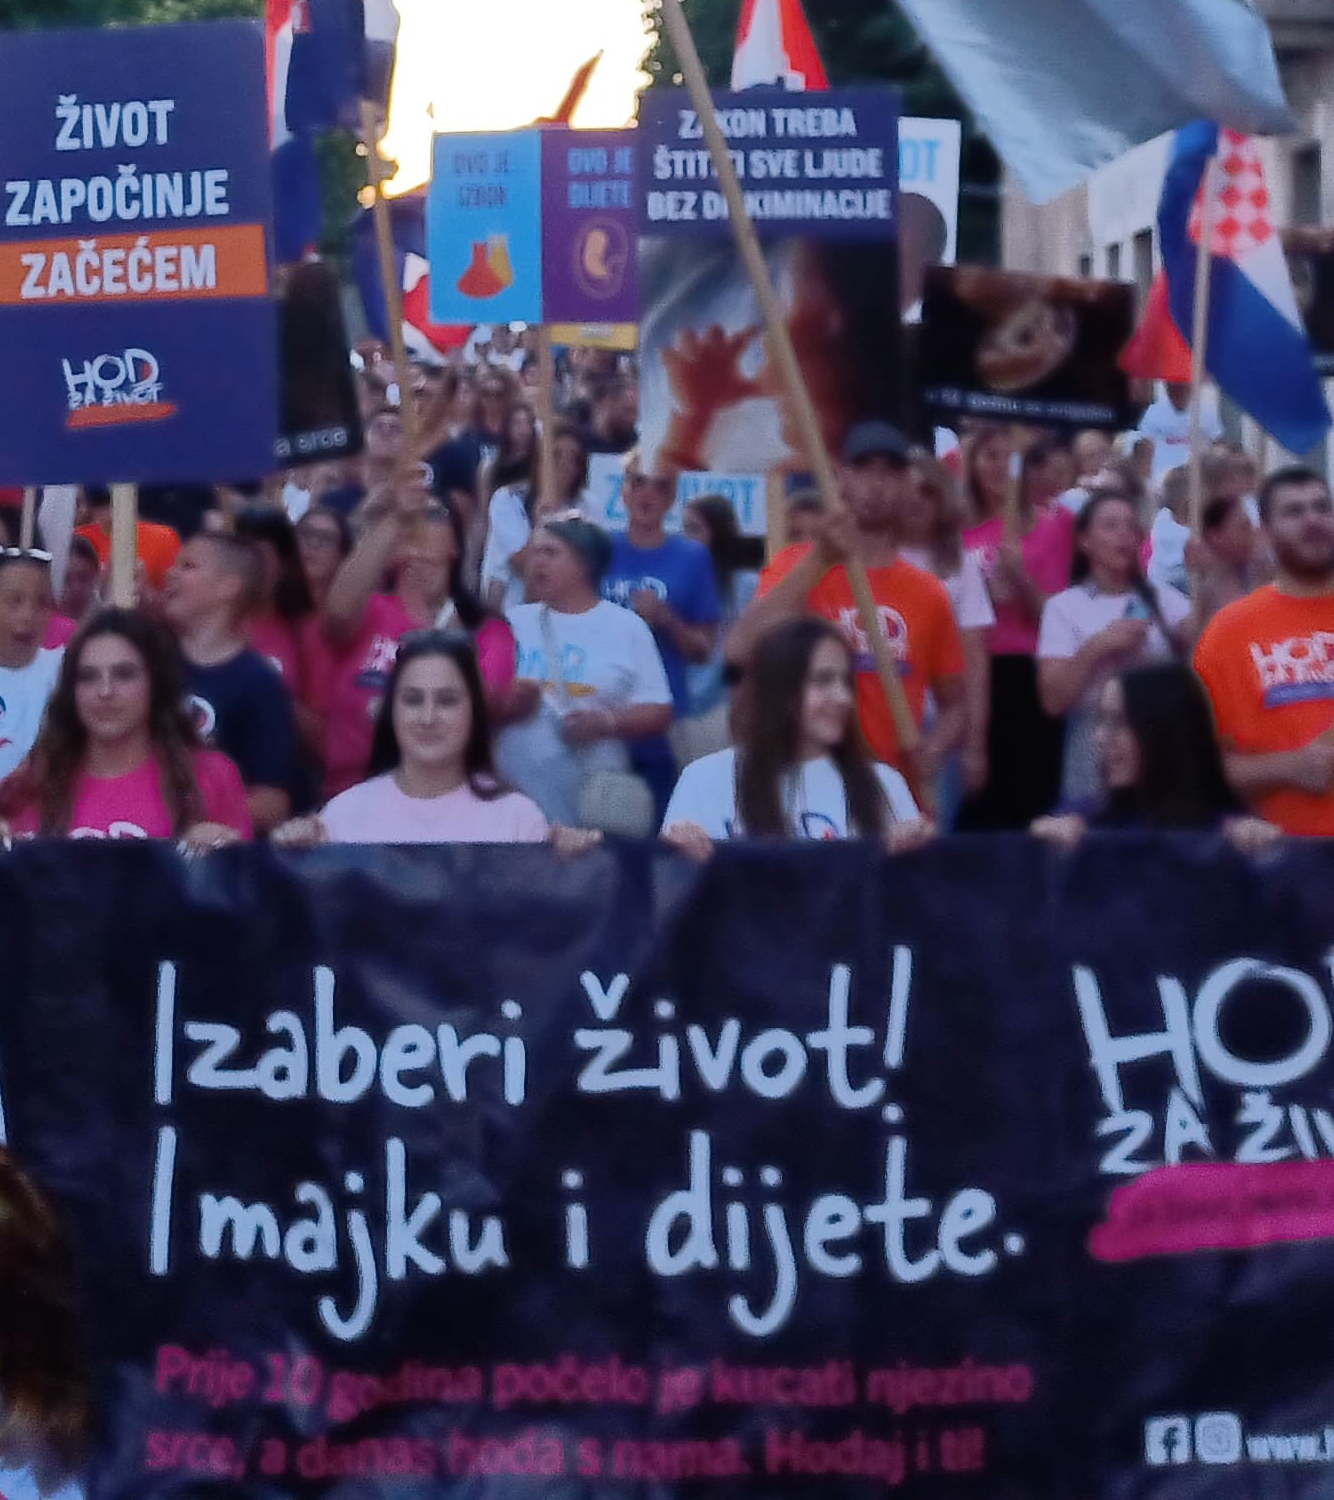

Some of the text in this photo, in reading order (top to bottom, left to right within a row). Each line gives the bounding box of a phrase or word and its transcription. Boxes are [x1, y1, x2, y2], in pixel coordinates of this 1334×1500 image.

[55, 93, 175, 151] ŽIVOT
[678, 107, 857, 139] ZKON TREBA
[750, 149, 800, 179] SVE
[803, 147, 884, 179] LJUDE
[5, 163, 229, 226] ZAPOČINJE
[647, 190, 696, 221] BEZ
[20, 235, 216, 299] ZAČEĆEM
[62, 348, 159, 393] HOD
[153, 943, 912, 1108] Izaberi život!
[1097, 1092, 1215, 1175] ZA
[198, 1135, 509, 1340] majku
[560, 1168, 589, 1268] i
[643, 1100, 1027, 1336] dijete.
[156, 1344, 256, 1407] Prije
[266, 1353, 322, 1405] 10
[493, 1354, 647, 1411] počelo
[712, 1356, 857, 1406] kucati
[867, 1357, 1033, 1416] njezino
[261, 1438, 287, 1475] a
[296, 1435, 435, 1480] danas
[449, 1429, 565, 1477] hoda
[577, 1438, 601, 1476] s
